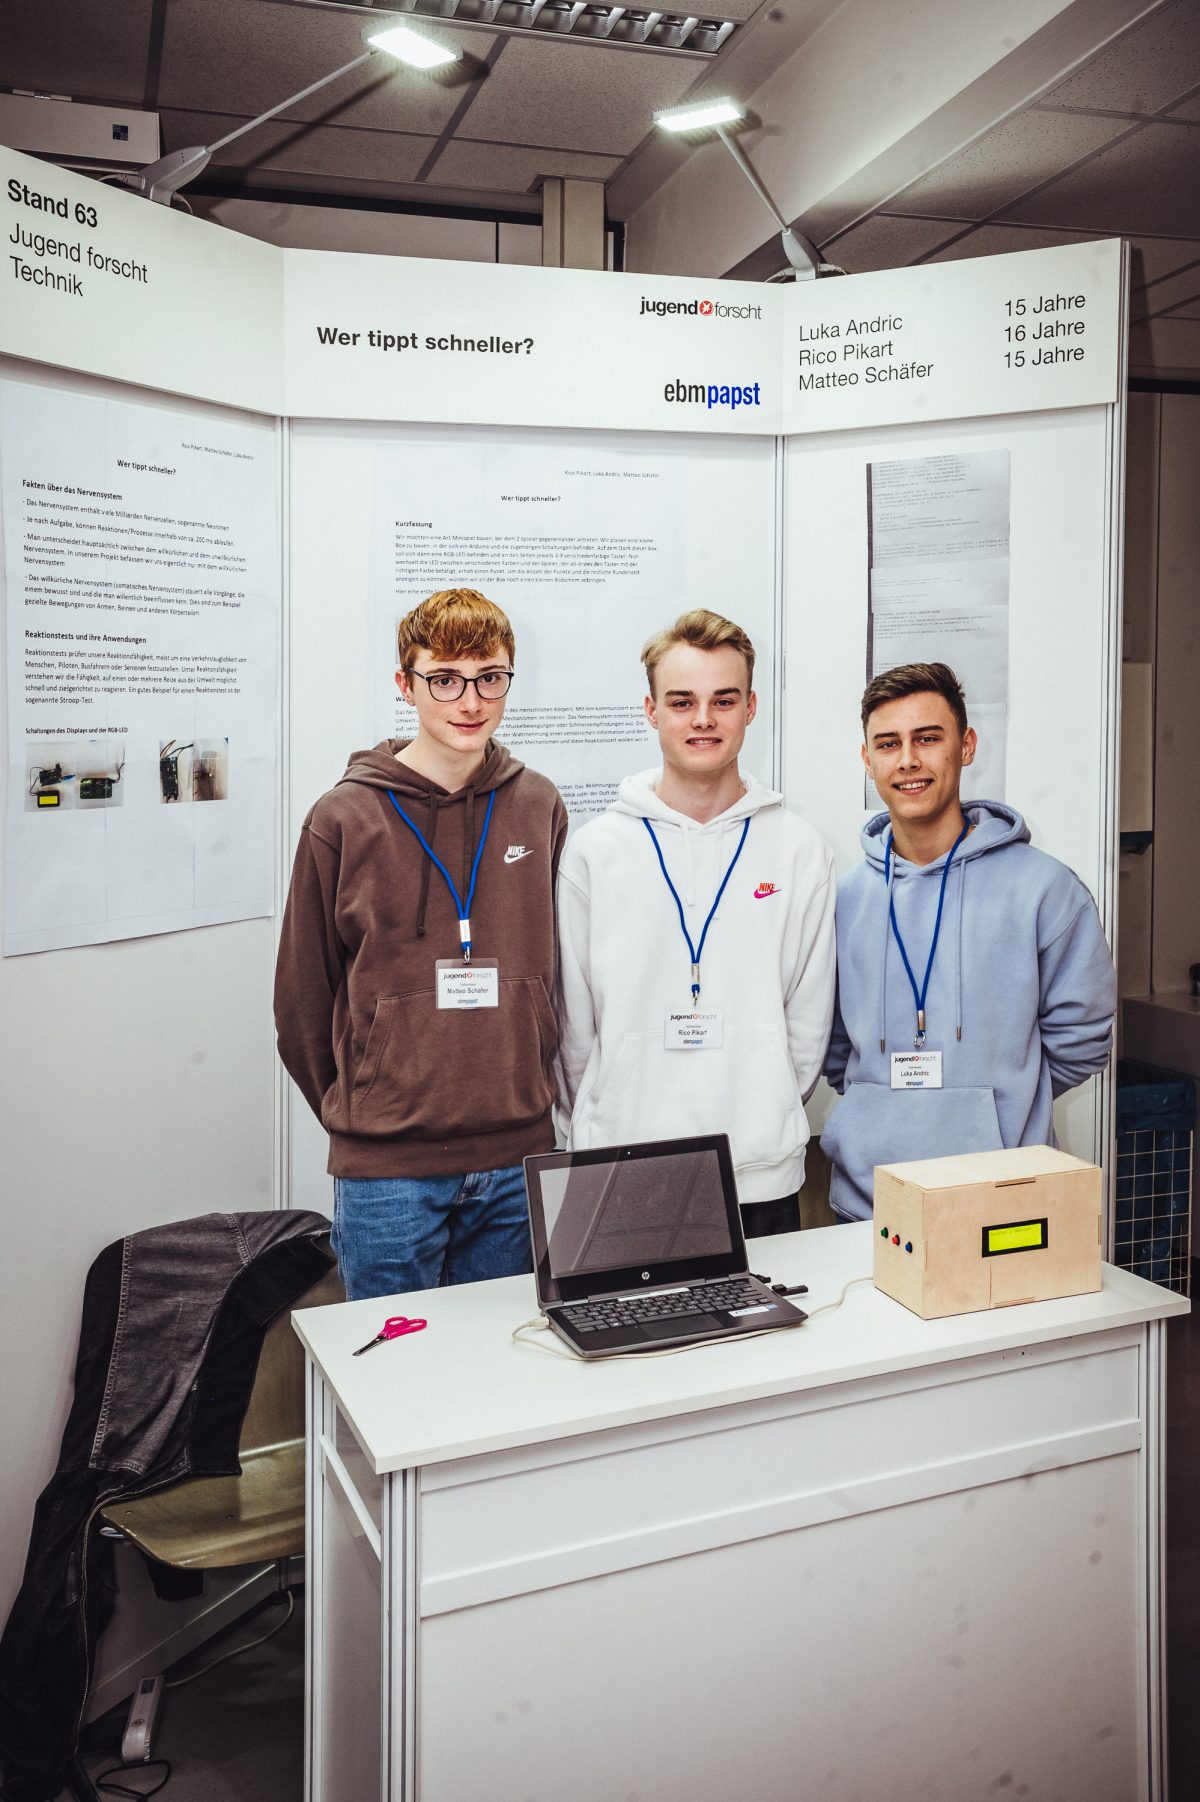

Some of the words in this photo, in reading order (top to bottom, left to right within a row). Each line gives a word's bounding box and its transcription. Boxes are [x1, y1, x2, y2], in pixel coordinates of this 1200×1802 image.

[8, 178, 68, 219] Stand
[75, 203, 98, 228] 63
[9, 222, 80, 263] Jugend
[87, 246, 148, 284] forscht
[10, 255, 84, 297] Technik
[640, 297, 698, 316] jugend
[715, 302, 762, 319] forscht
[1004, 299, 1026, 316] 15
[1032, 294, 1086, 314] Jahre
[799, 324, 841, 341] Luka
[845, 314, 903, 336] Andric
[1004, 325, 1026, 342] 16
[1032, 320, 1086, 340] Jahre
[316, 326, 361, 346] Wer
[367, 330, 418, 351] tippt
[425, 334, 534, 355] schneller?
[799, 349, 837, 366] Rico
[843, 340, 894, 361] Pikart
[1003, 350, 1026, 368] 15
[1031, 346, 1085, 366] Jahre
[799, 372, 859, 390] Matteo
[865, 361, 934, 384] Schäfer
[664, 378, 760, 410] ebmpapst
[117, 459, 130, 468] Wer
[132, 462, 147, 471] tippt
[149, 465, 176, 475] schneller?
[23, 480, 45, 489] Fakten
[48, 483, 62, 492] über
[64, 485, 75, 494] das
[77, 487, 122, 500] Nervensystem
[39, 500, 79, 512] Nervensystem
[50, 518, 74, 529] Aufgabe,
[43, 536, 80, 545] unterscheidet
[101, 552, 119, 561] Projekt
[41, 575, 73, 584] willkürliche
[74, 578, 112, 588] Nervensystem
[44, 586, 68, 595] bewusst
[49, 599, 84, 609] Bewegungen
[25, 630, 74, 639] Reaktionstests
[103, 634, 146, 645] Anwendungen
[25, 661, 56, 670] Menschen,
[59, 685, 93, 693] zielgerichtet
[507, 845, 525, 856] NIKE
[759, 883, 775, 892] NIKE
